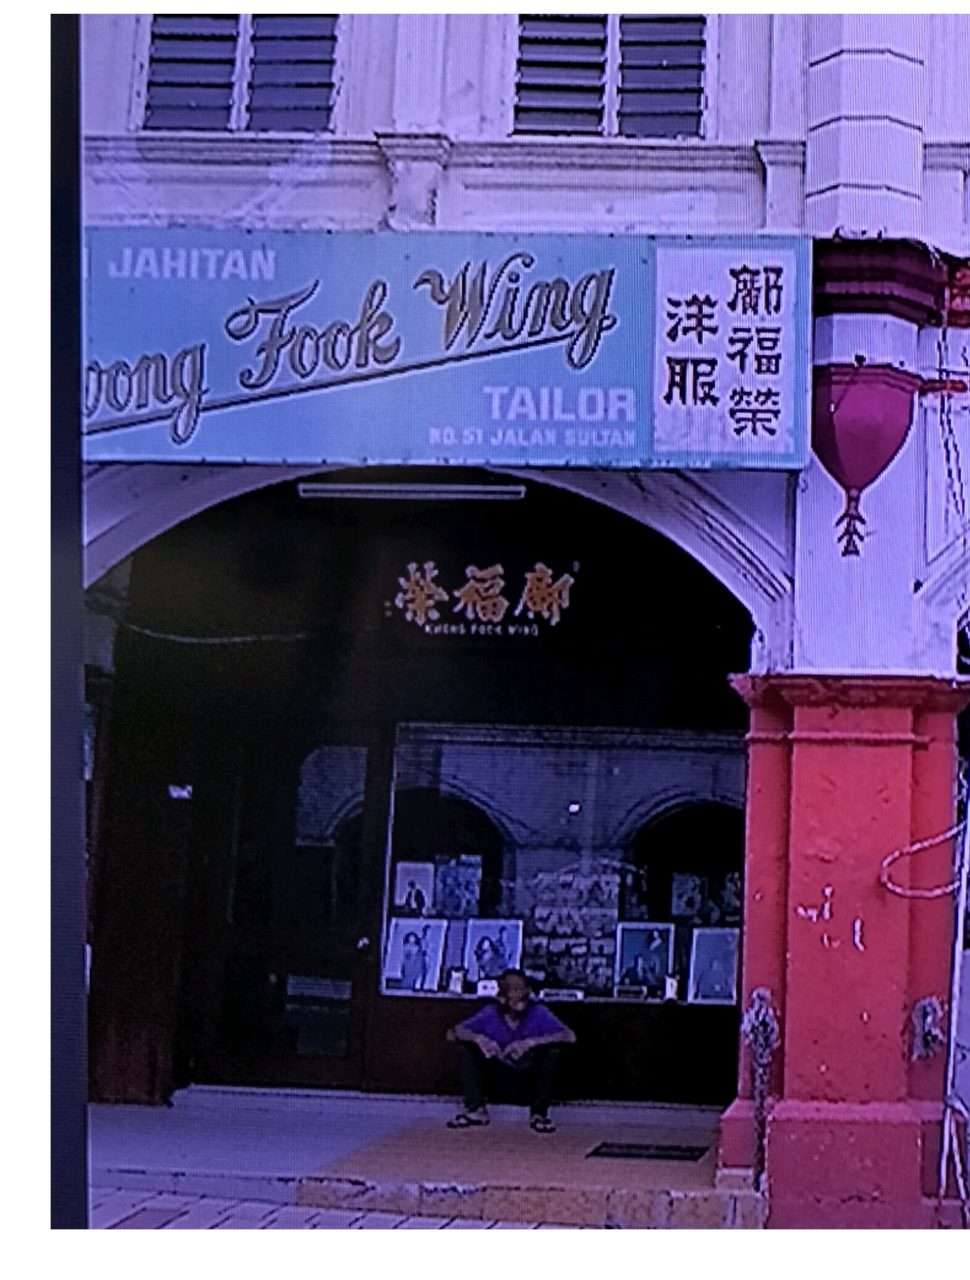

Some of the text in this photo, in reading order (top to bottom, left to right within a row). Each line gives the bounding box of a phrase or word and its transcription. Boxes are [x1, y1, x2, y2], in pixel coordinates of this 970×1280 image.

[108, 247, 276, 280] JAHITAN
[224, 278, 402, 390] Fook
[412, 251, 617, 371] Wing
[663, 293, 720, 407] 洋服
[483, 386, 636, 421] TAILOR
[488, 428, 556, 448] JALAN
